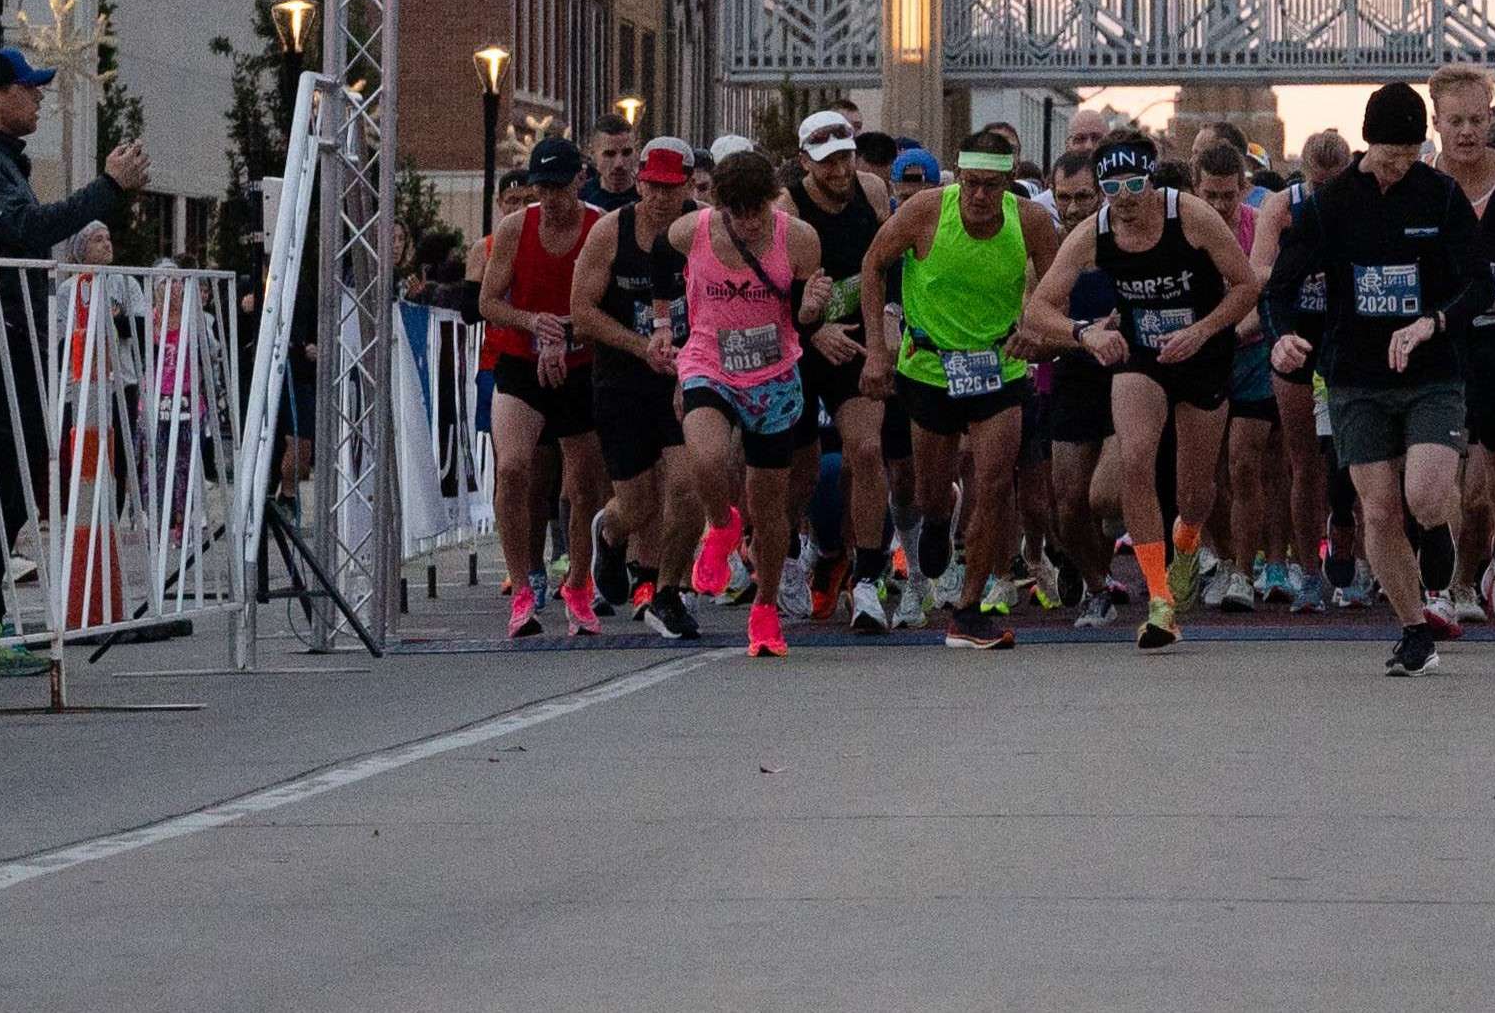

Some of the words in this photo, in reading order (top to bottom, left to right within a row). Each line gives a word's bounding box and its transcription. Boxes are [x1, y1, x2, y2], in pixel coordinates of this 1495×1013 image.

[1300, 295, 1327, 312] 220
[1357, 295, 1398, 314] 2020
[723, 352, 762, 372] 4018
[948, 375, 983, 397] 1526
